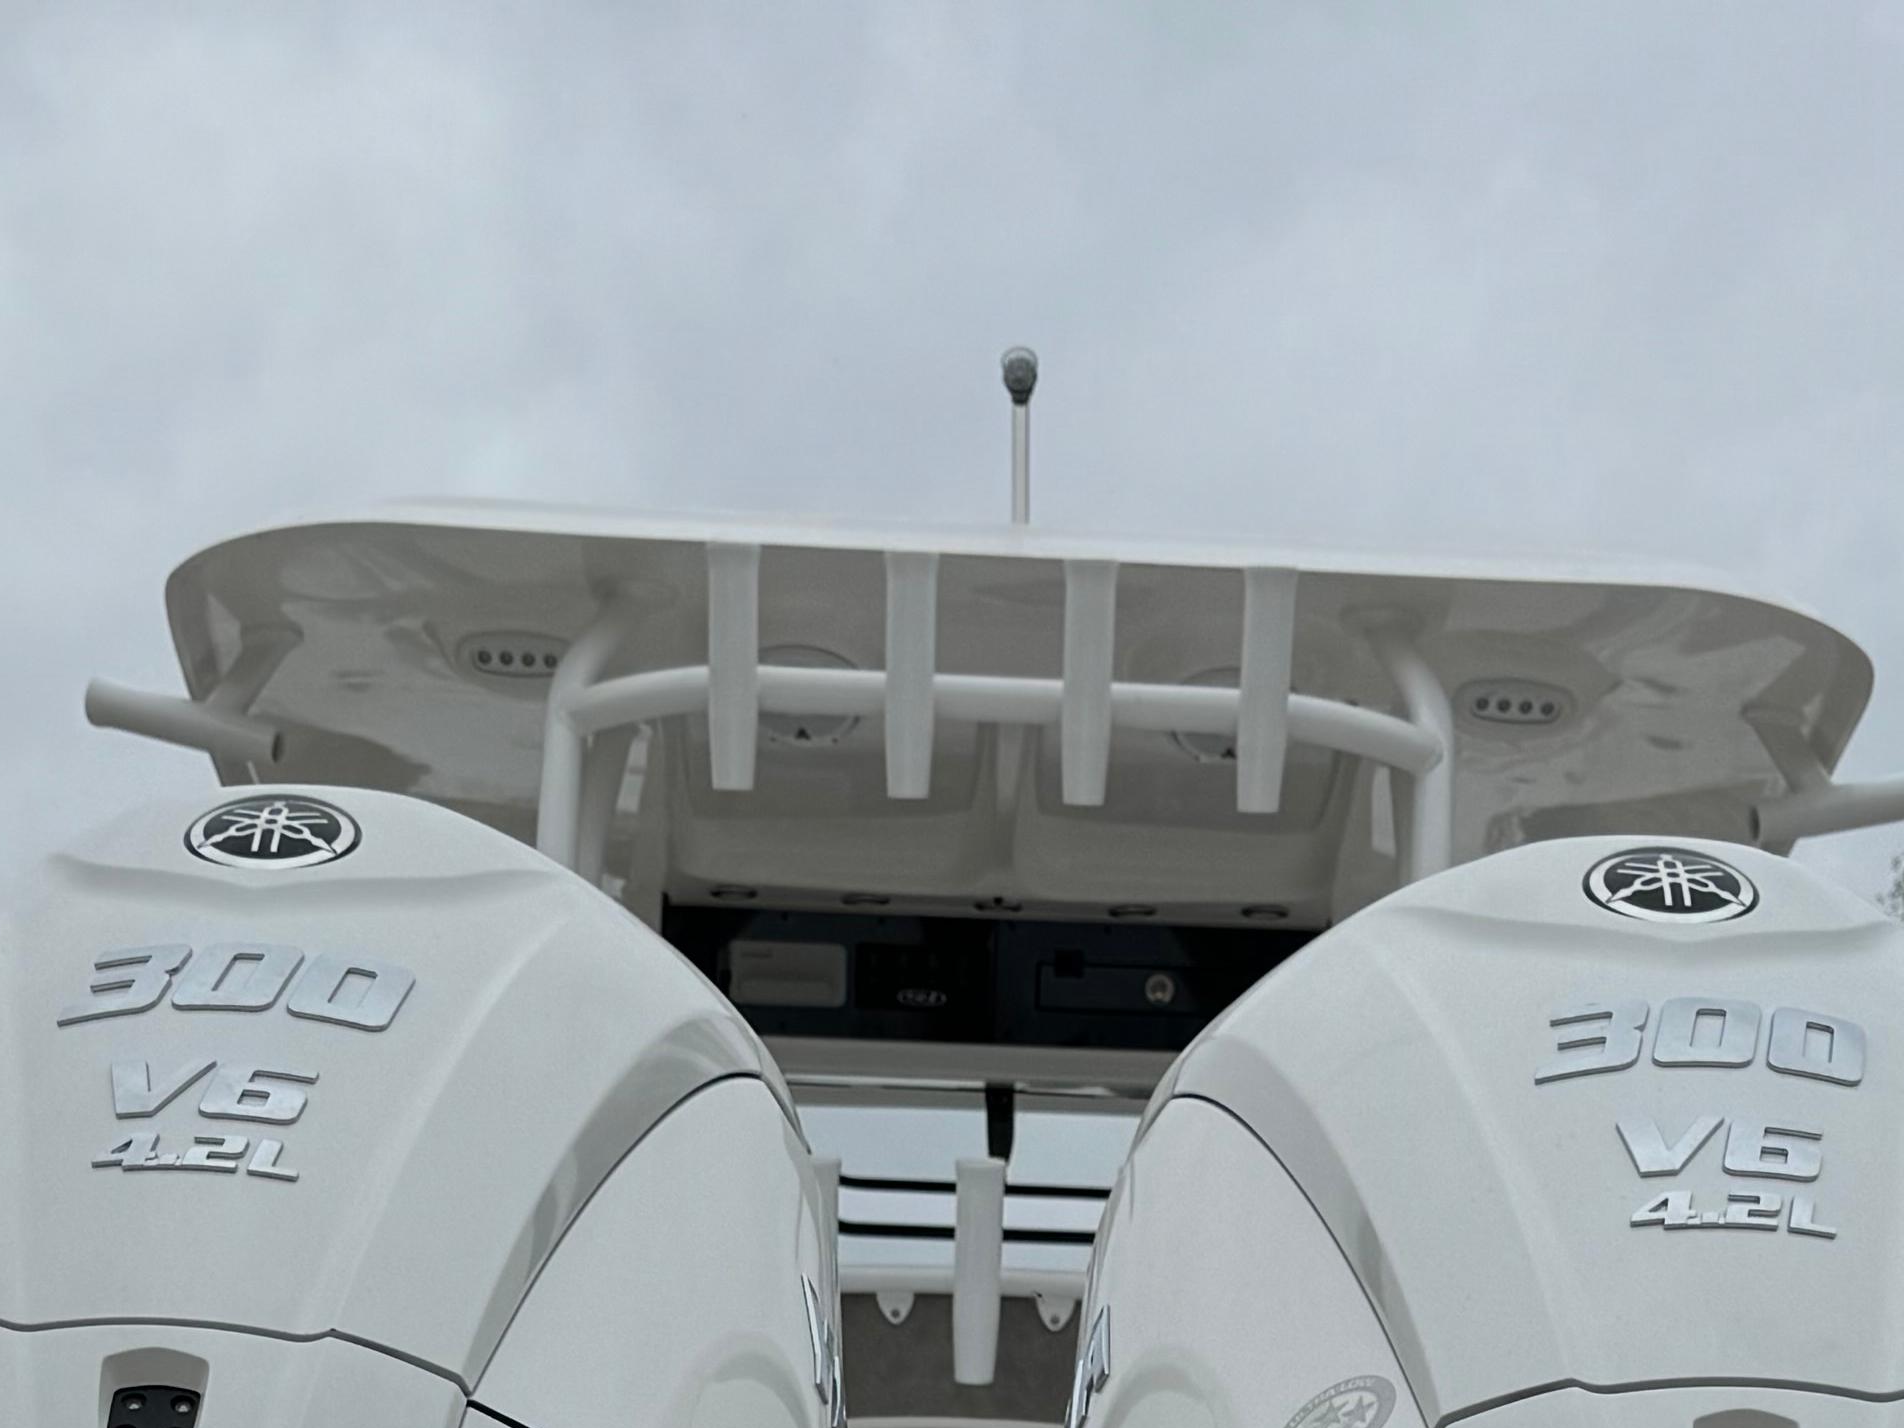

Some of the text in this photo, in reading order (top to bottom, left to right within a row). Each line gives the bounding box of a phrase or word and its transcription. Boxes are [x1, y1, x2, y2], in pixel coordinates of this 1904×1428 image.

[57, 942, 416, 1032] 300
[1534, 996, 1867, 1088] 300
[110, 1060, 320, 1125] V6
[91, 1131, 299, 1182] 4.2L
[1615, 1114, 1823, 1182] V6
[1629, 1190, 1837, 1240] 4.2L
